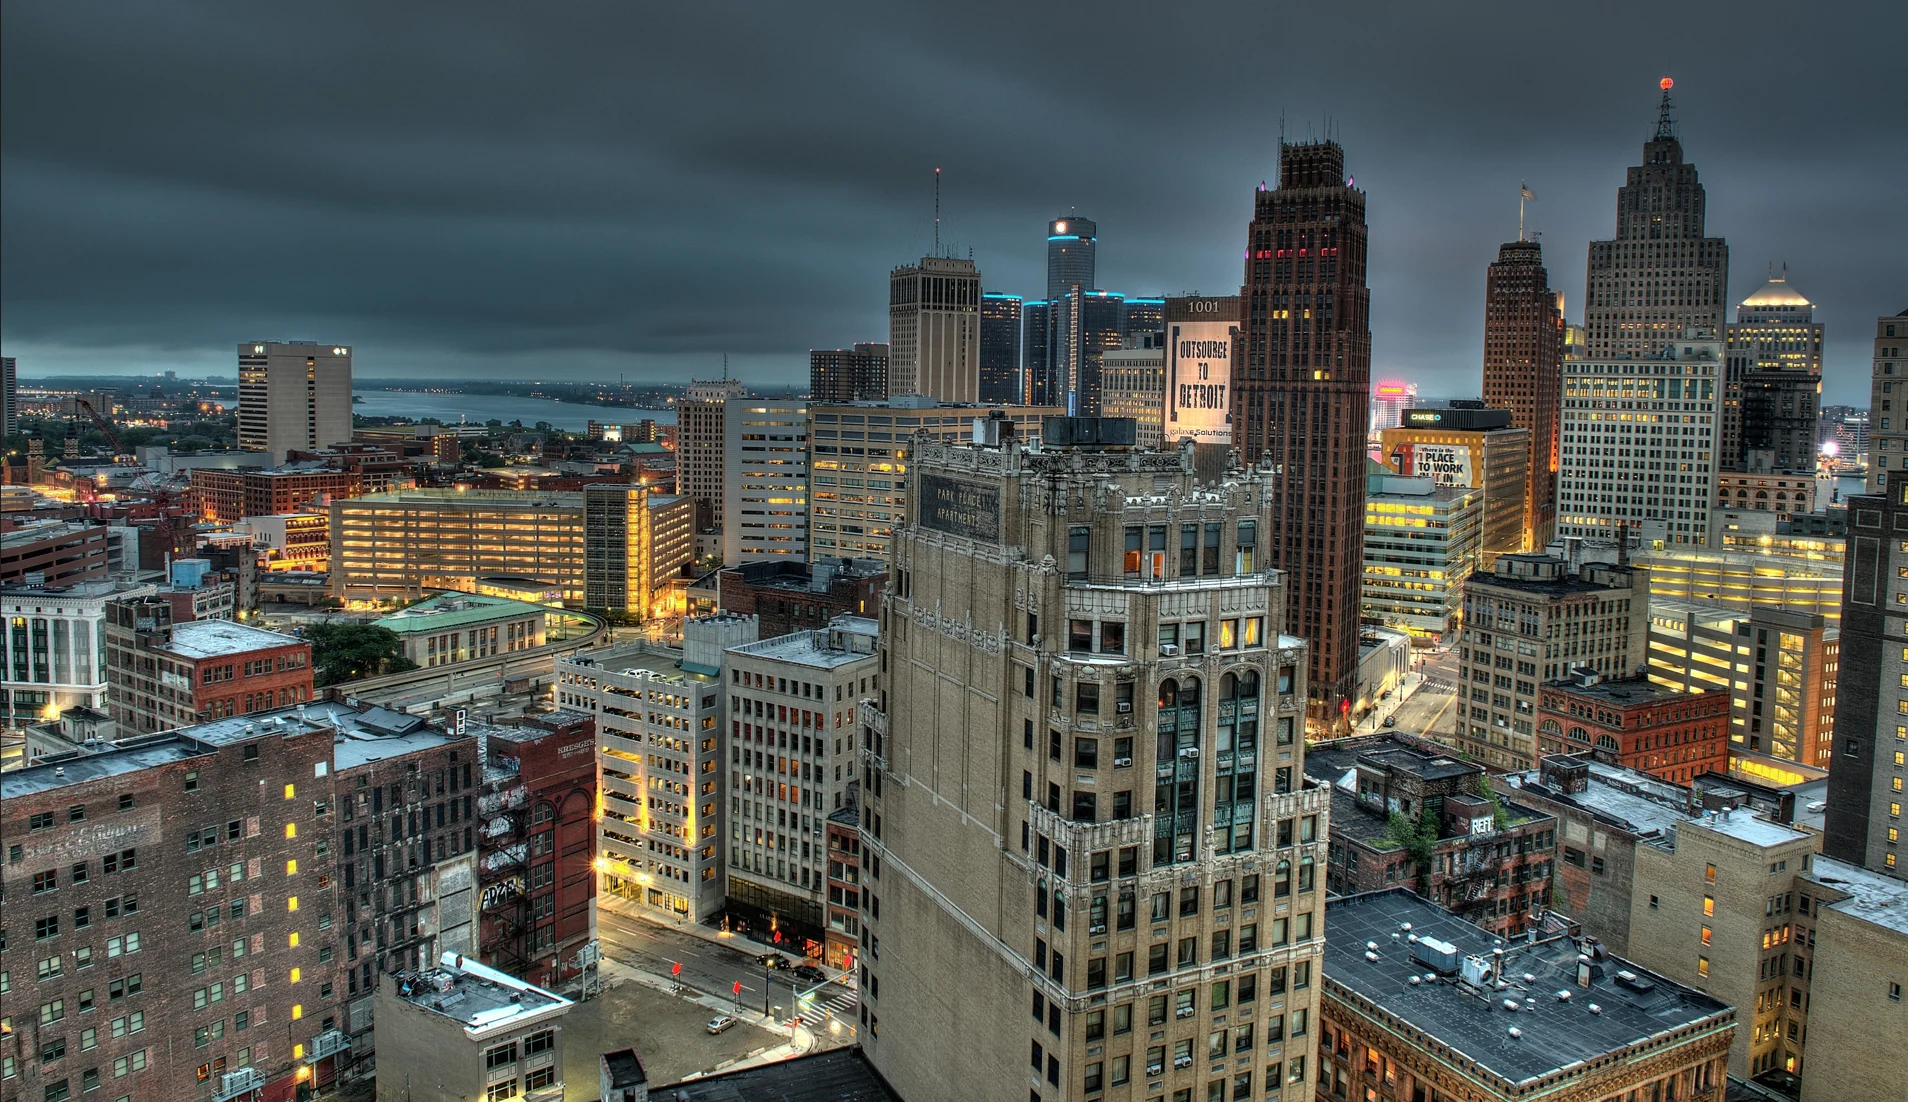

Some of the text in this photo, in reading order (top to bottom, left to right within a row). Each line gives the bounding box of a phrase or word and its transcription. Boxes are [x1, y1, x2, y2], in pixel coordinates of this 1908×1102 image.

[1188, 301, 1219, 313] 1001
[1180, 340, 1227, 359] OUTSOURCE
[1198, 362, 1208, 380] TO
[1179, 383, 1225, 409] DETROIT
[1425, 453, 1455, 463] PLACE
[1418, 462, 1463, 473] TO WORK
[1443, 474, 1453, 483] IN
[937, 488, 981, 507] PARK PLACE
[936, 507, 980, 527] APARTMENTS
